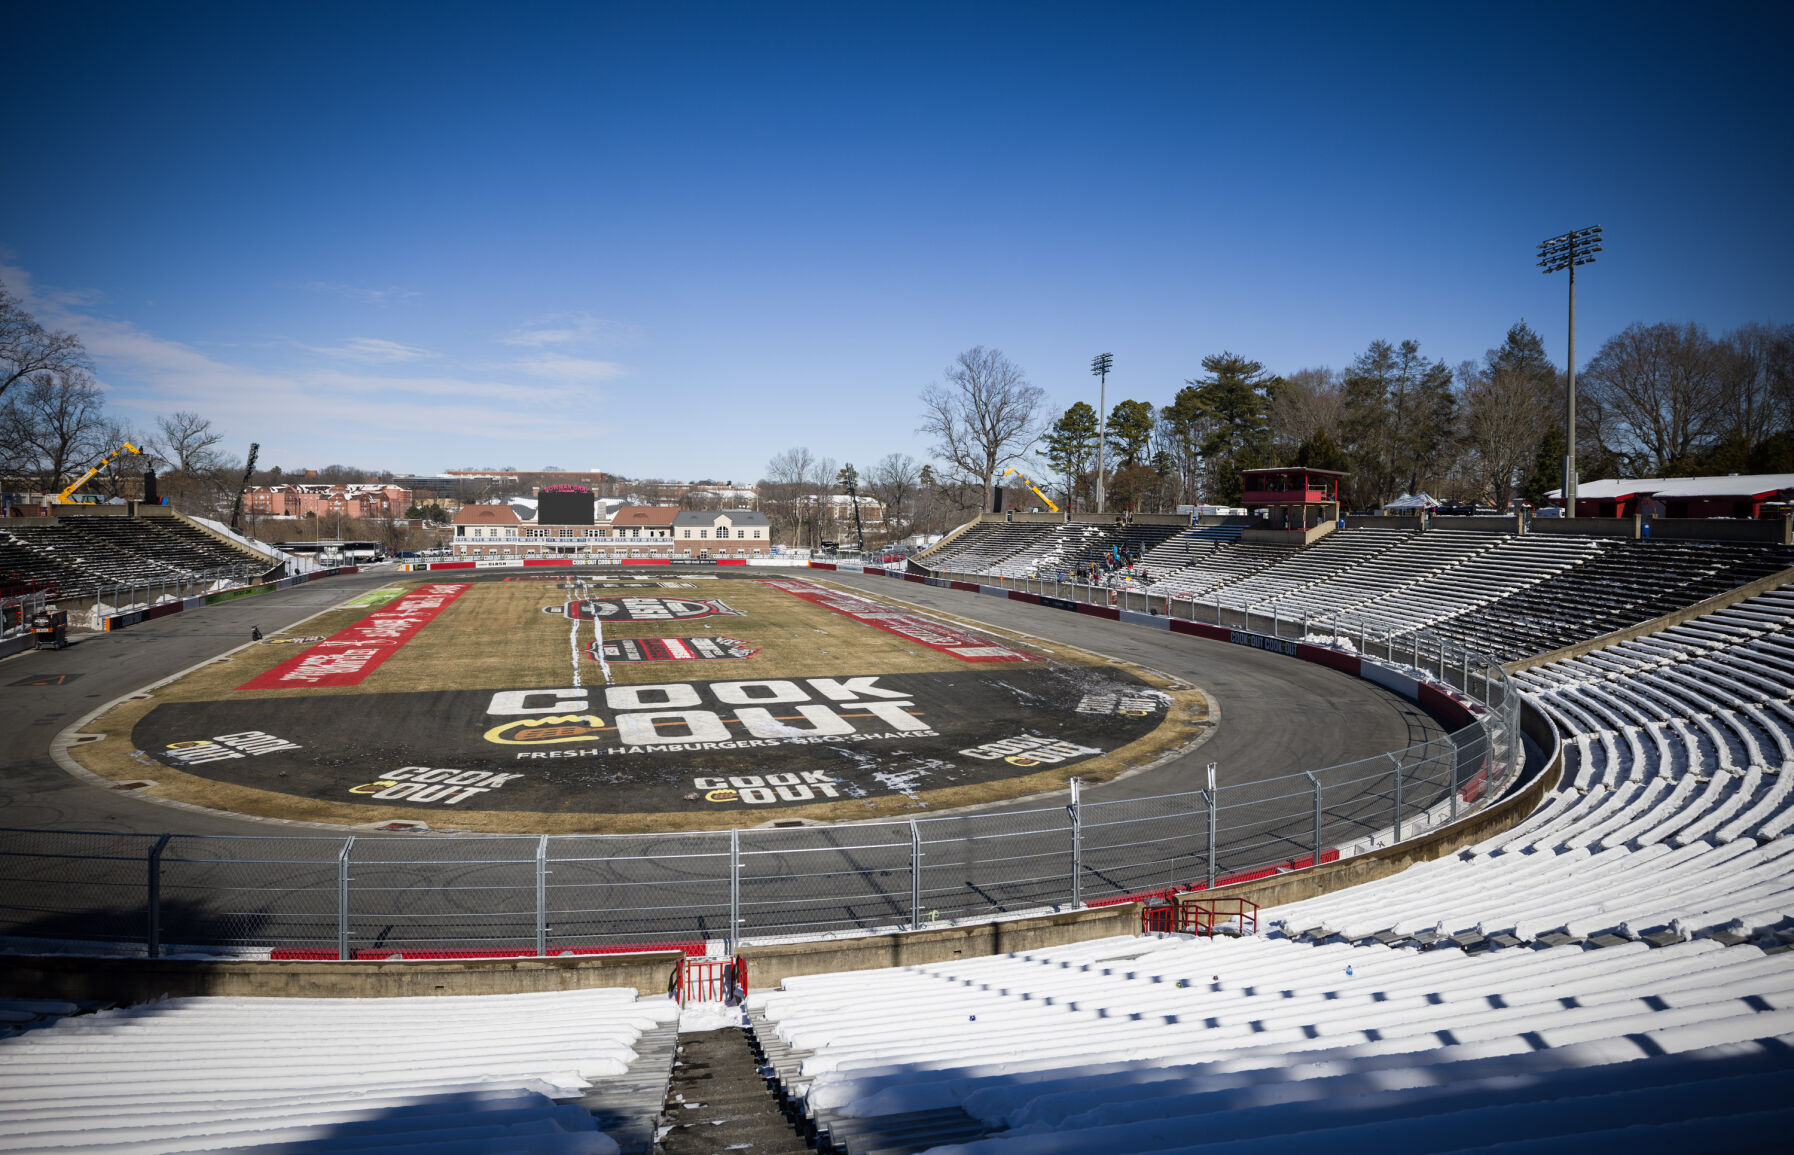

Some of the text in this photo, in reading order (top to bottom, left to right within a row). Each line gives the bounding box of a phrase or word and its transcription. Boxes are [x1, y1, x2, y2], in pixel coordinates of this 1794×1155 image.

[1230, 631, 1298, 656] COOK OUT COOK OUT
[486, 676, 914, 715] COOK
[615, 701, 932, 745] OUT
[516, 748, 598, 760] FRESH
[607, 737, 781, 755] HAMBURGERS
[850, 730, 941, 742] SHAKES
[958, 733, 1059, 760] COOK
[378, 766, 525, 788] COOK
[693, 769, 834, 790] COOK
[371, 782, 491, 804] OUT
[737, 782, 840, 804] OUT
